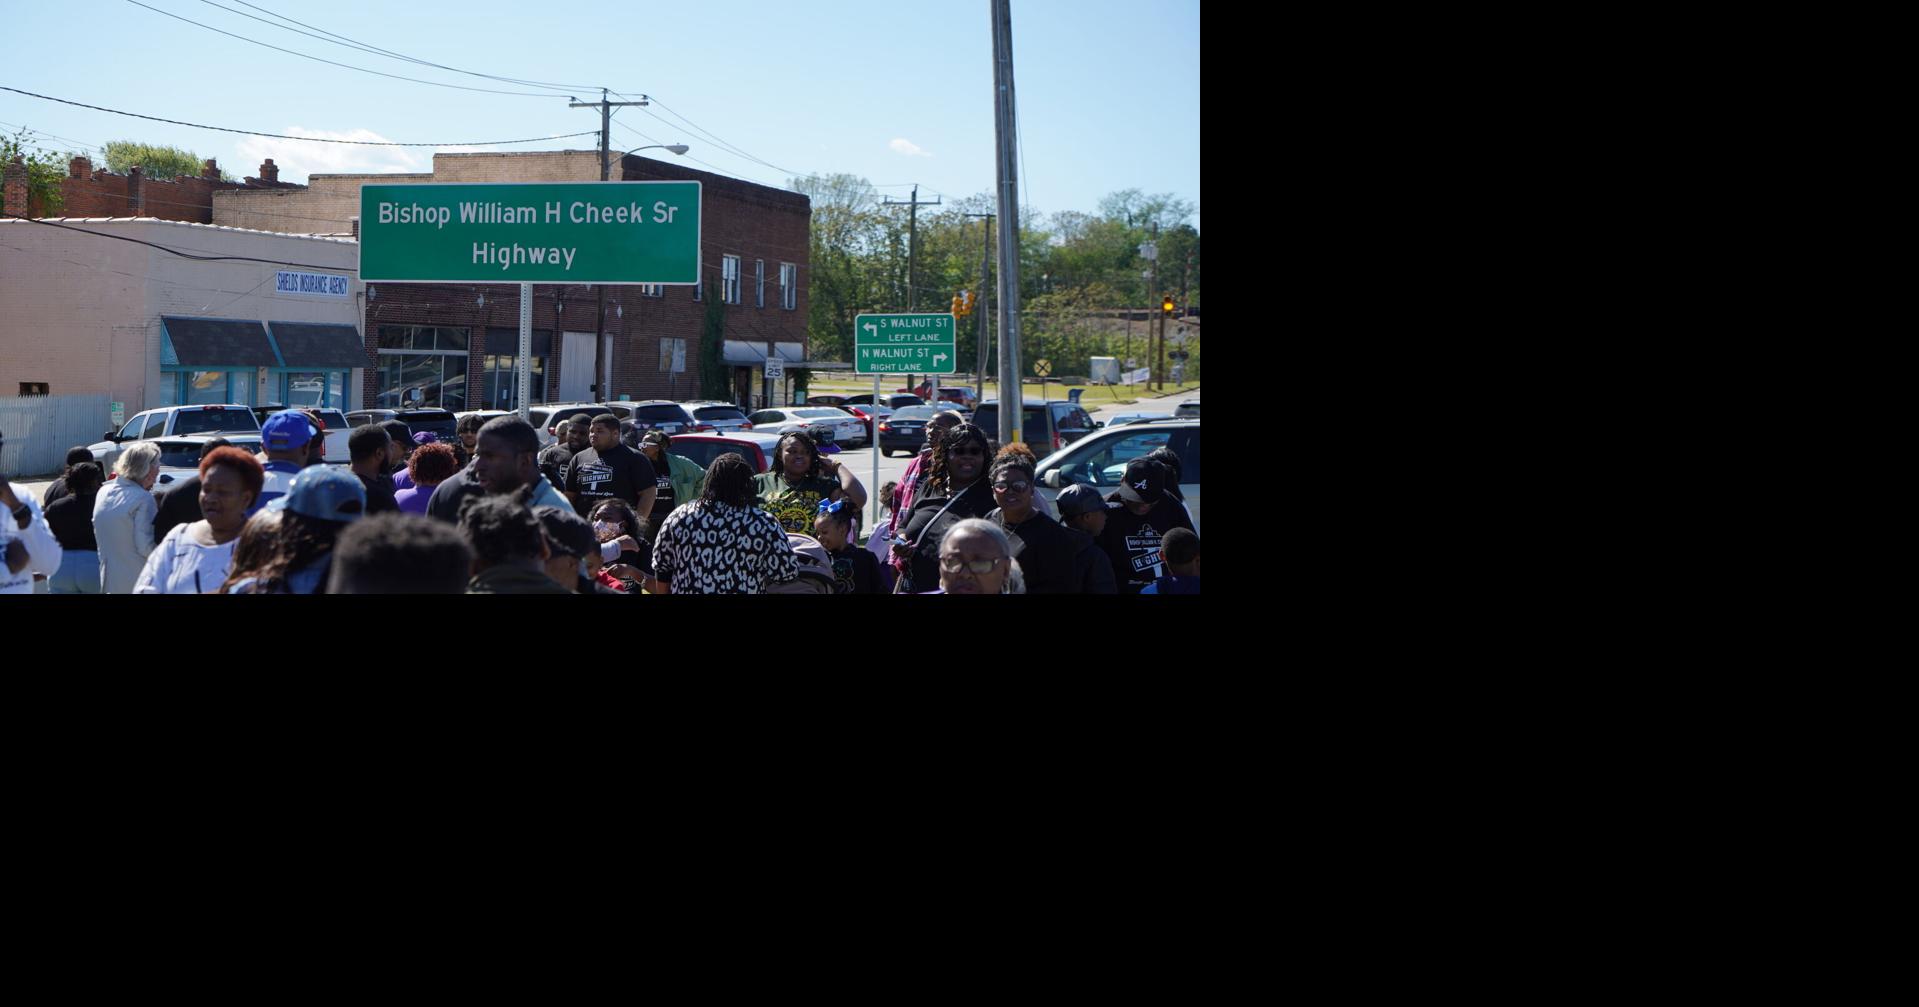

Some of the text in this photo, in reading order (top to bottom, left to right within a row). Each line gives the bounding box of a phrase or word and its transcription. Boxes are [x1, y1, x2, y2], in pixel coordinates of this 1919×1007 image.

[379, 201, 678, 229] Bishop William H Cheek Sr
[473, 243, 576, 270] Highway
[278, 273, 348, 294] SHIELDS INSURANCE AGENCY
[880, 318, 948, 328] S WALNUT ST
[862, 348, 929, 357] N WALNUT ST
[768, 368, 781, 376] 25
[582, 474, 610, 483] HIGHWAY
